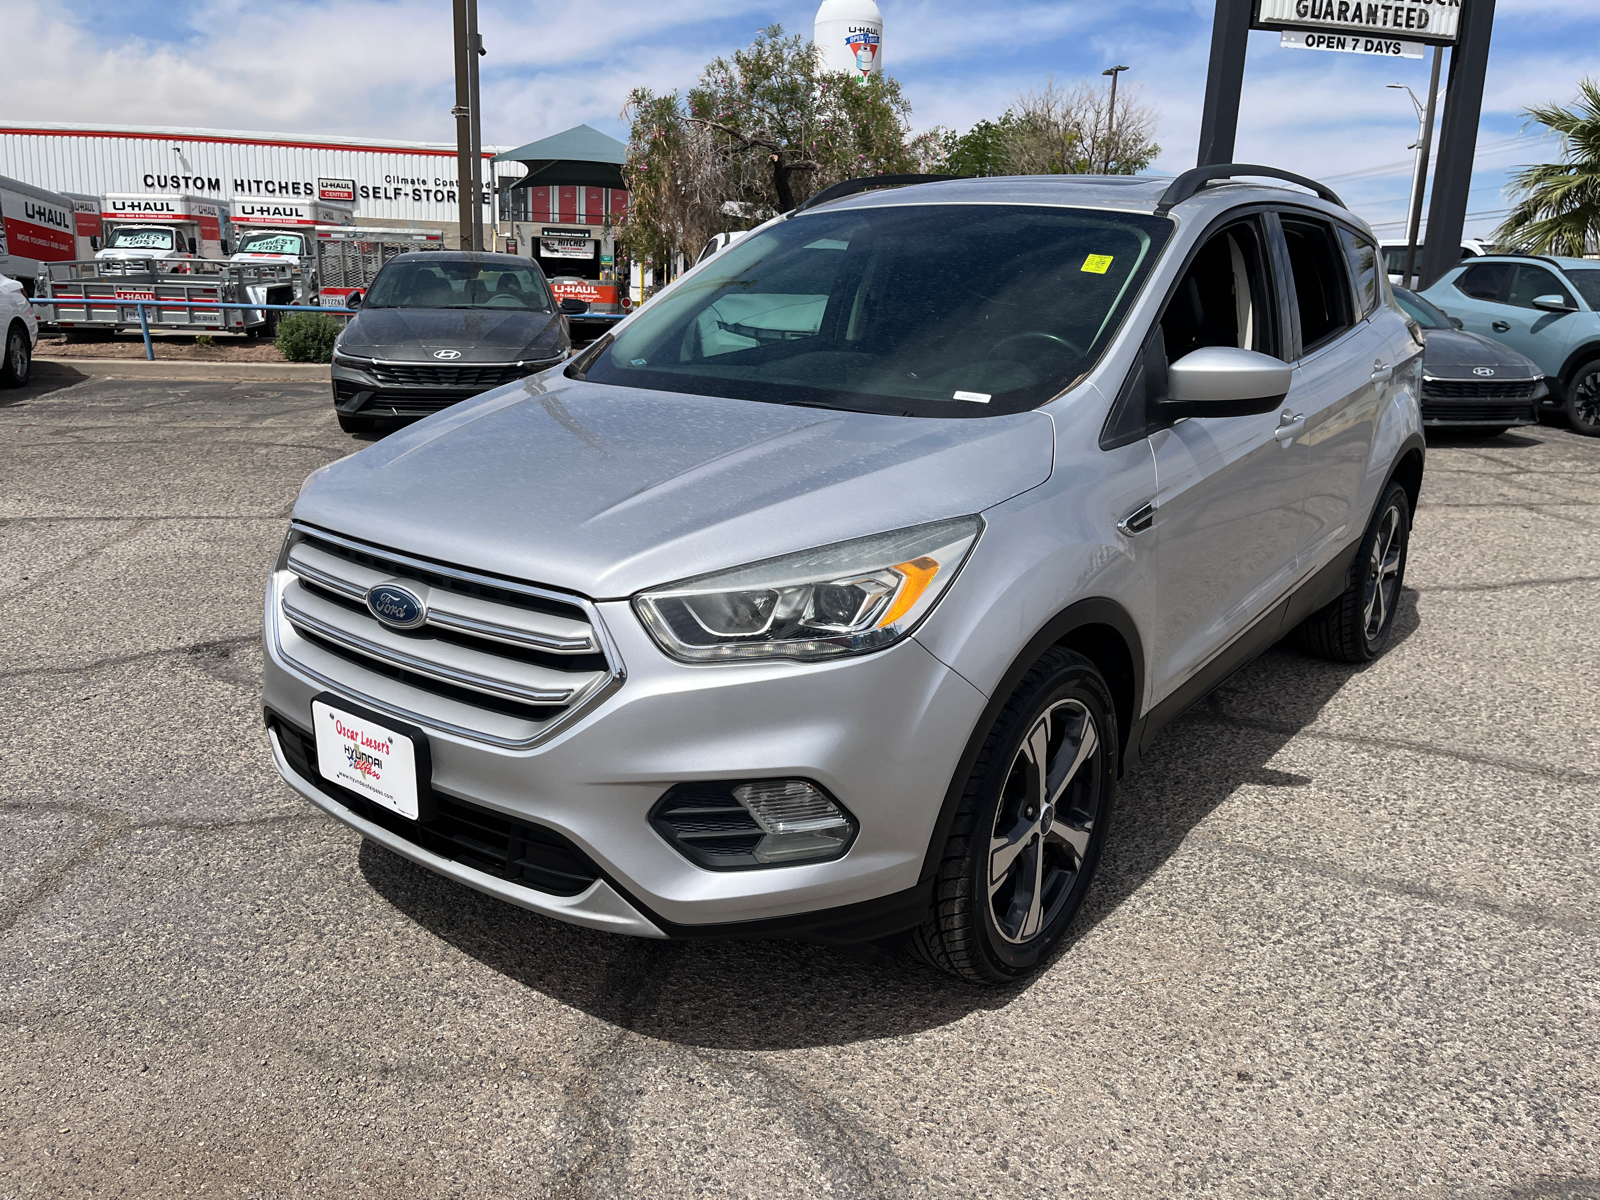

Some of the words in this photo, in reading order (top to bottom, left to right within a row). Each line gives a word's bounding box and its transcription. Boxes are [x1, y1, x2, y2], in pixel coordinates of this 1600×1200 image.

[1295, 0, 1430, 29] GUARANTEED
[848, 27, 879, 35] U-HAUL
[1305, 34, 1346, 50] OPEN
[1352, 38, 1360, 51] 7
[1364, 40, 1402, 55] DAYS
[143, 174, 221, 191] CUSTOM
[234, 178, 314, 195] HITCHES
[321, 181, 352, 189] U-HAUL
[385, 174, 427, 186] Climate
[360, 186, 491, 204] SELF-STORE
[74, 201, 95, 213] U-HAUL
[112, 201, 175, 212] U-HAUL
[241, 205, 304, 217] U-HAUL
[24, 201, 70, 229] U-HAUL
[123, 234, 168, 242] LOWEST
[252, 238, 296, 248] LOWEST
[557, 239, 587, 247] HITCHES
[554, 285, 598, 294] U-HAUL
[376, 592, 407, 618] Ford
[335, 719, 359, 742] Oscar
[360, 731, 390, 755] Leeser's
[343, 744, 383, 769] HYUNDAI
[355, 760, 365, 771] El
[363, 762, 381, 780] Paso
